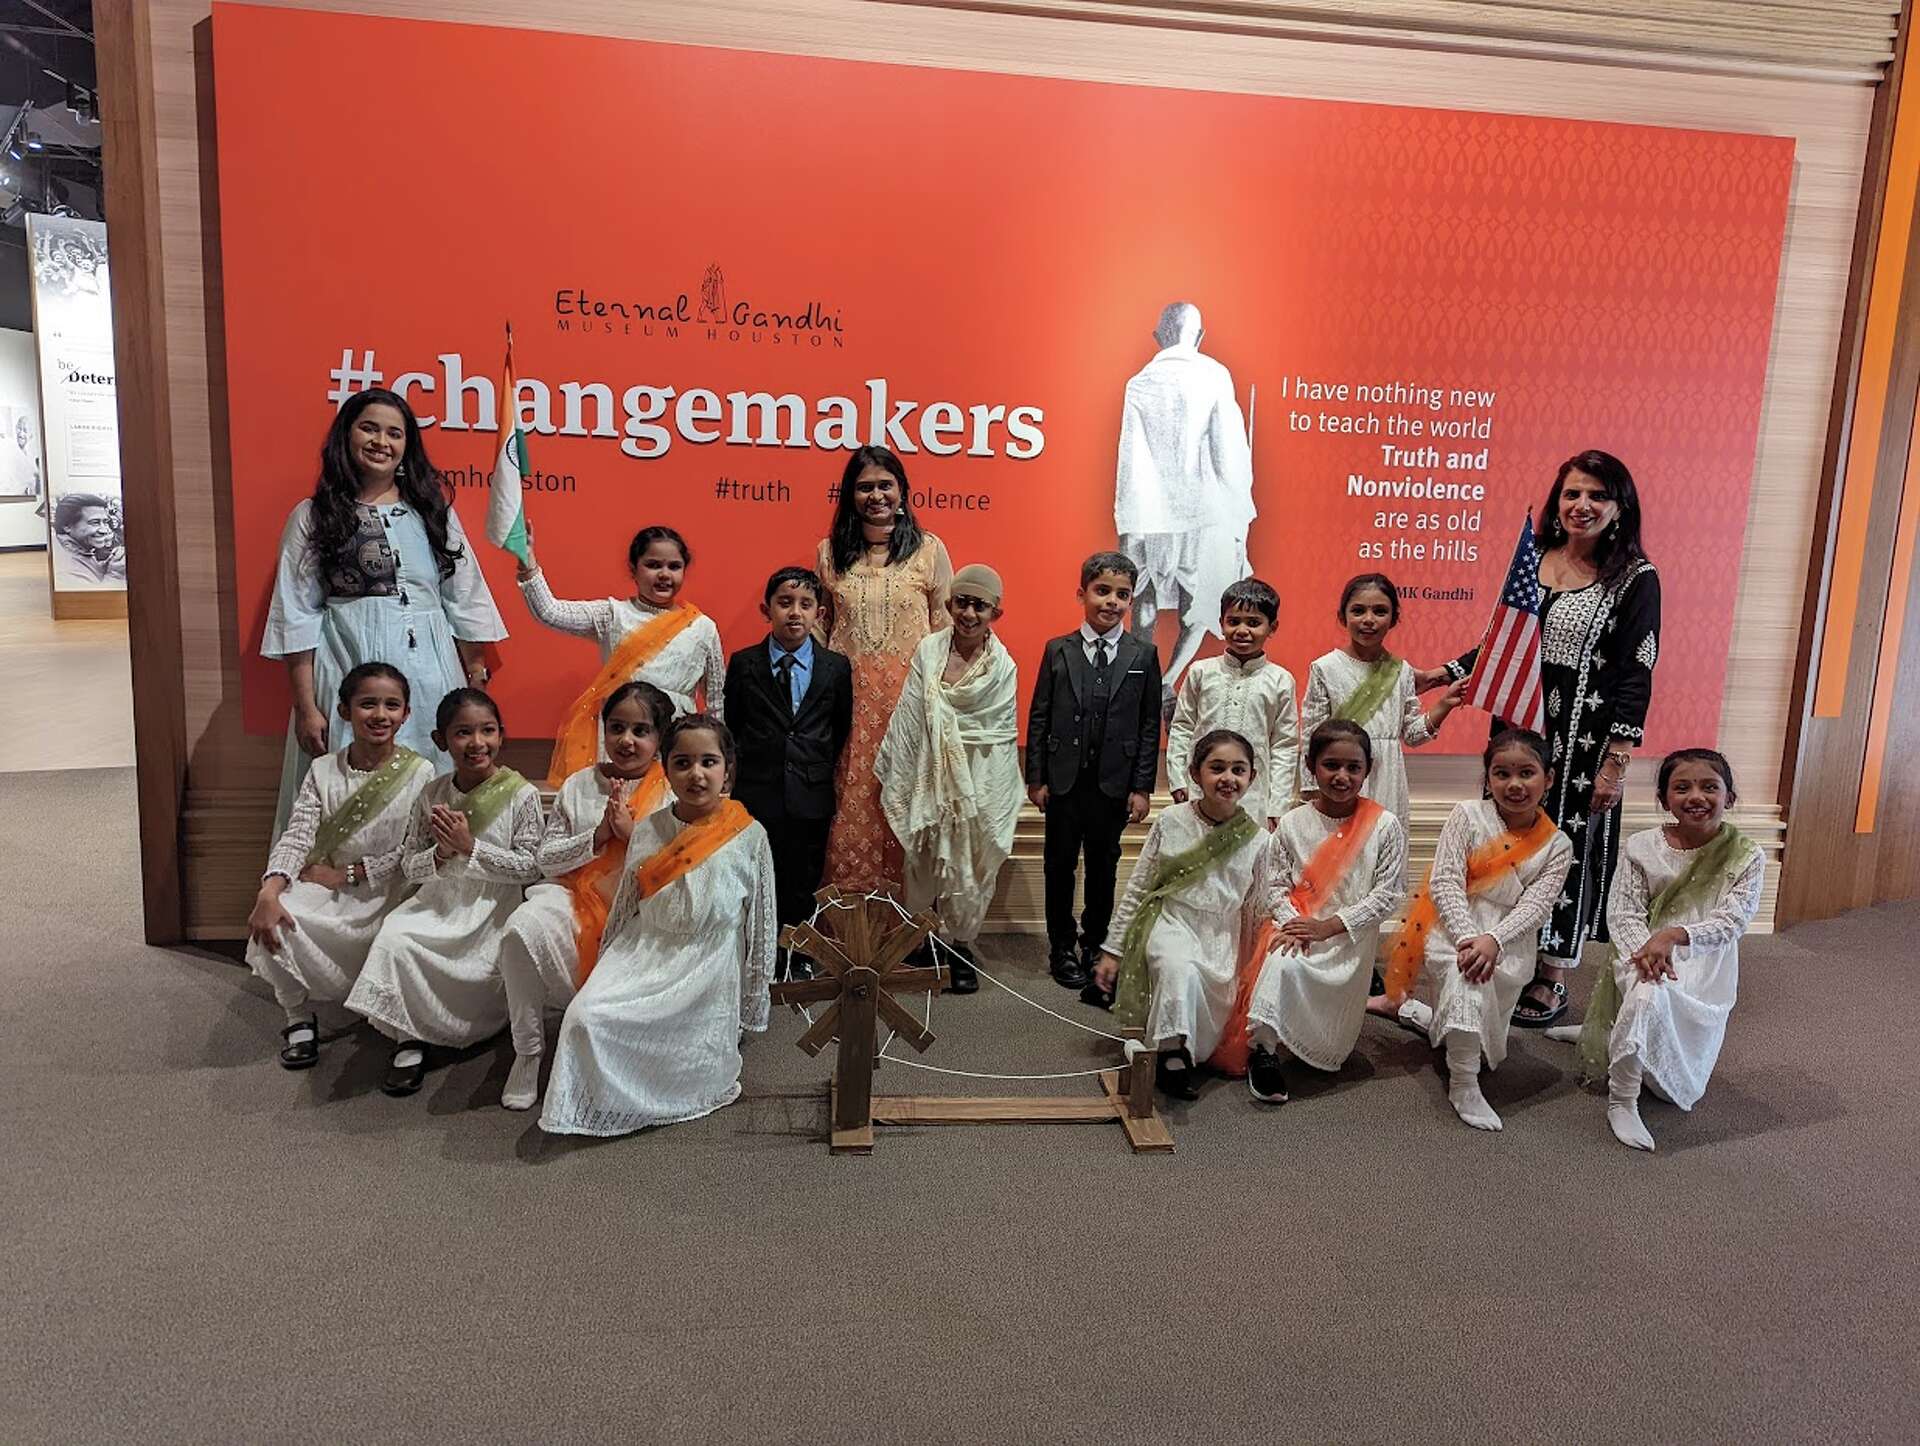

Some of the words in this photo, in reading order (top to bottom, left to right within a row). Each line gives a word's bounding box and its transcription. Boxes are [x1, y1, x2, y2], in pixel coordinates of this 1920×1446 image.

[556, 289, 690, 322] Eternal
[732, 301, 844, 332] Gandhi
[557, 320, 679, 338] MUSEUM
[707, 329, 843, 348] HOUSTON
[69, 371, 115, 385] Deter
[328, 348, 1045, 459] #changemakers
[1281, 376, 1288, 398] I
[1296, 377, 1349, 401] have
[1356, 381, 1444, 411] nothing
[1449, 390, 1496, 408] new
[1289, 411, 1311, 432] to
[1318, 412, 1380, 434] teach
[1387, 414, 1424, 436] the
[1430, 417, 1492, 439] world
[1381, 444, 1441, 469] Truth
[1446, 448, 1489, 470] and
[715, 477, 790, 502] #truth
[1347, 475, 1485, 501] Nonviolence
[1374, 511, 1409, 529] are
[1415, 513, 1440, 530] as
[1446, 510, 1482, 532] old
[1358, 542, 1383, 559] as
[1390, 538, 1425, 560] the
[1432, 538, 1478, 562] hills
[1396, 586, 1418, 599] MK
[1422, 586, 1474, 600] Gandhi
